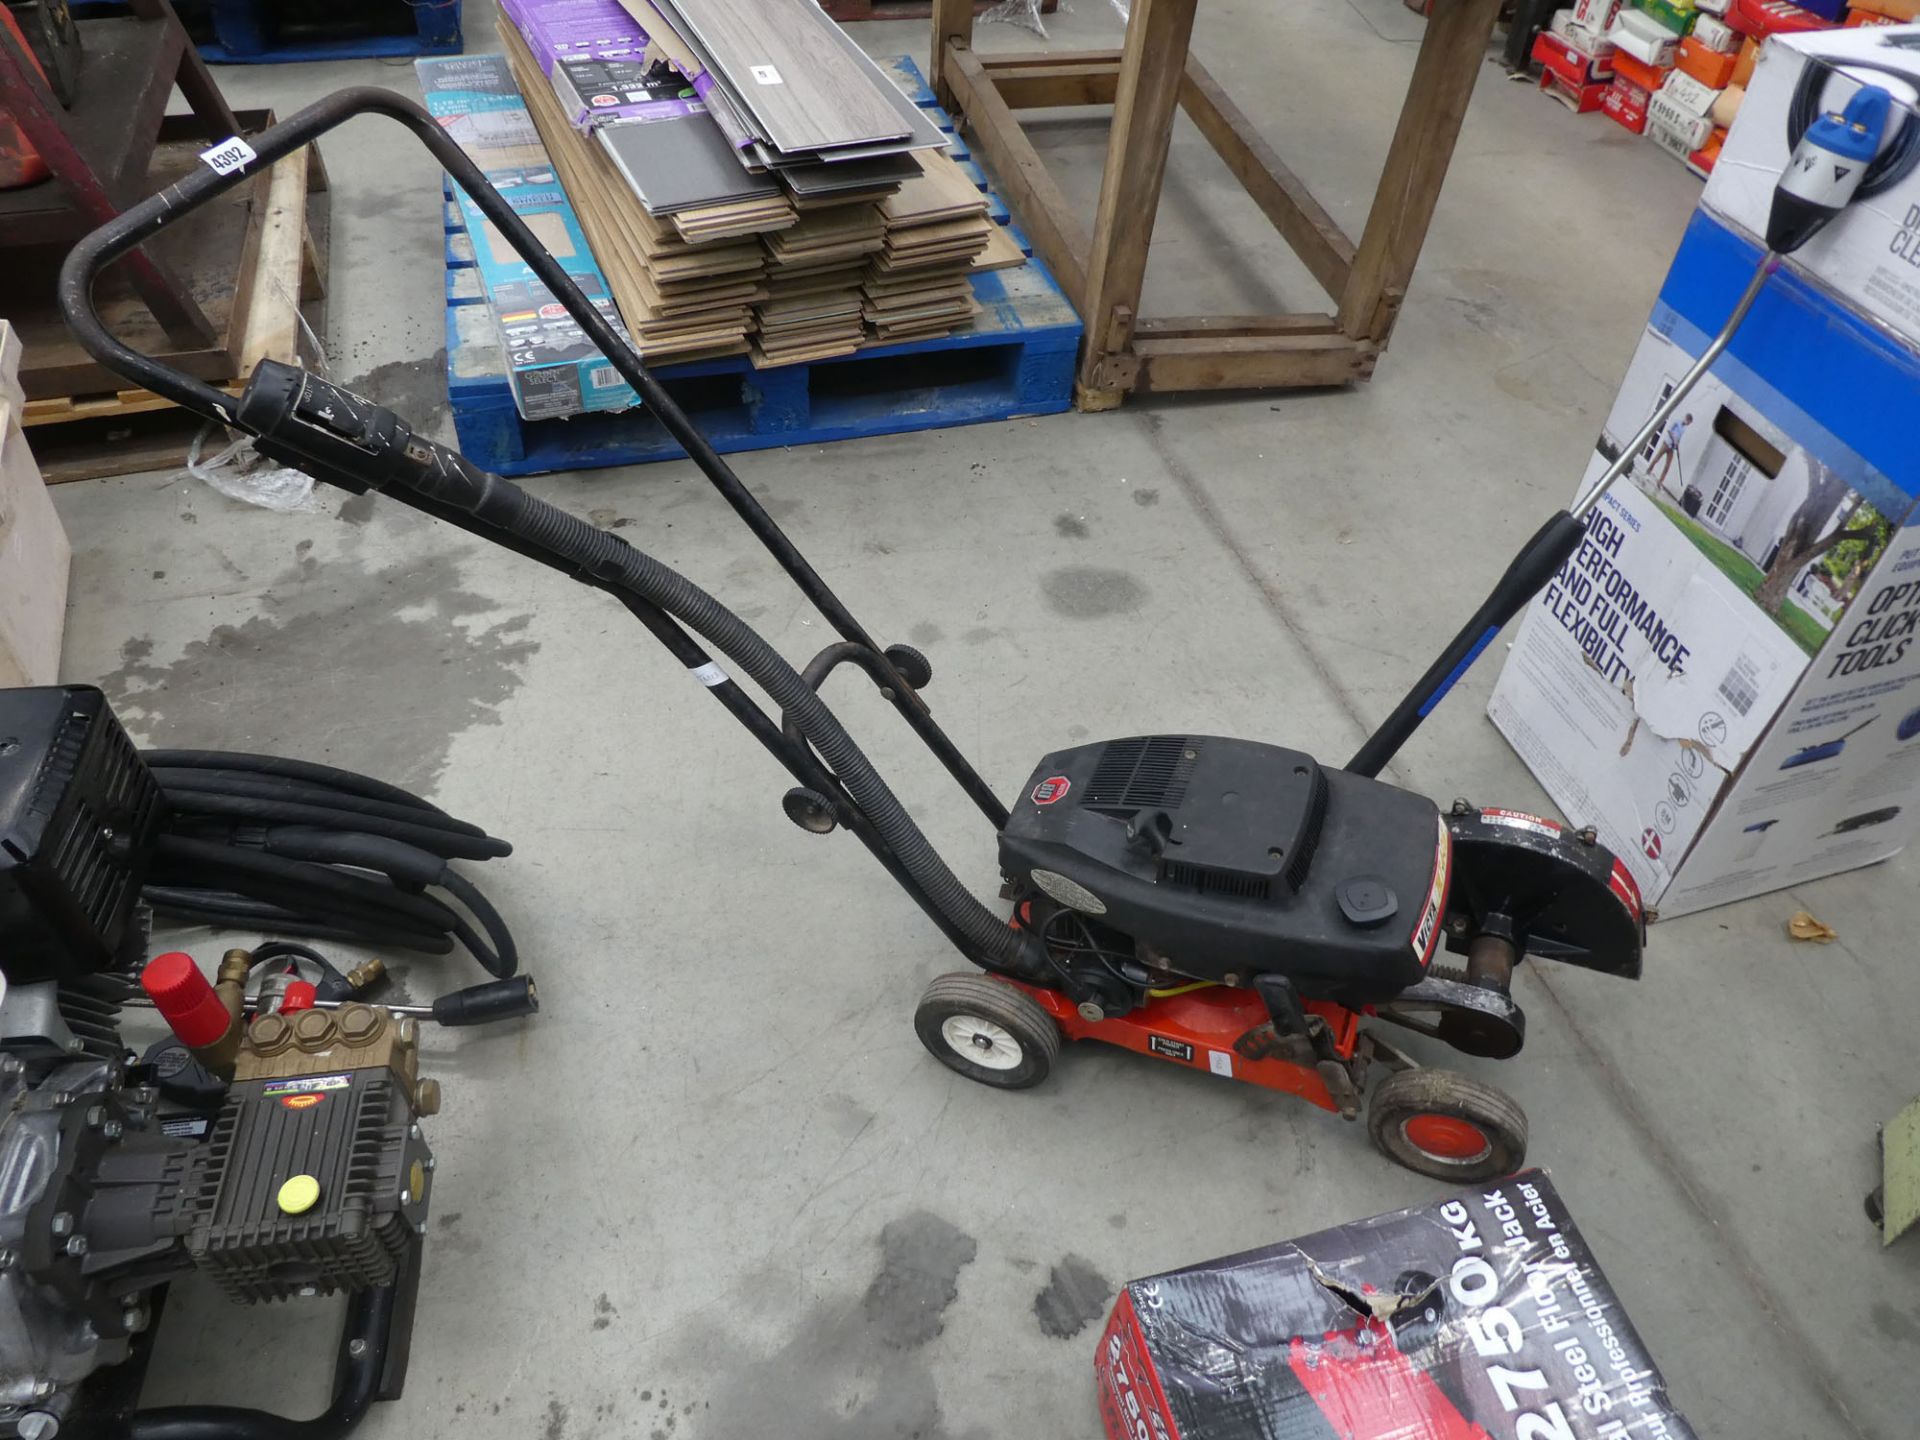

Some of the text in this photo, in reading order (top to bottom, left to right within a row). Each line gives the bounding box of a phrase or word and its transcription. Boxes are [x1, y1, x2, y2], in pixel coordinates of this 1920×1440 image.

[211, 146, 247, 170] 4392
[1889, 229, 1920, 268] CLE
[1584, 506, 1625, 559] HIGH
[1619, 507, 1642, 533] SERIES
[1554, 560, 1629, 653] AND FULL
[1573, 538, 1690, 673] ERFORMANCE
[1827, 637, 1913, 679] TOOLS
[1500, 809, 1542, 823] CAUTION
[1483, 1189, 1532, 1252] Jack
[1516, 1182, 1556, 1231] Acier
[1547, 1232, 1570, 1259] en
[1440, 1200, 1577, 1440] 2750 KG
[1520, 1260, 1570, 1334] Floor
[1109, 1334, 1150, 1440] 2750
[1553, 1336, 1612, 1416] Steel
